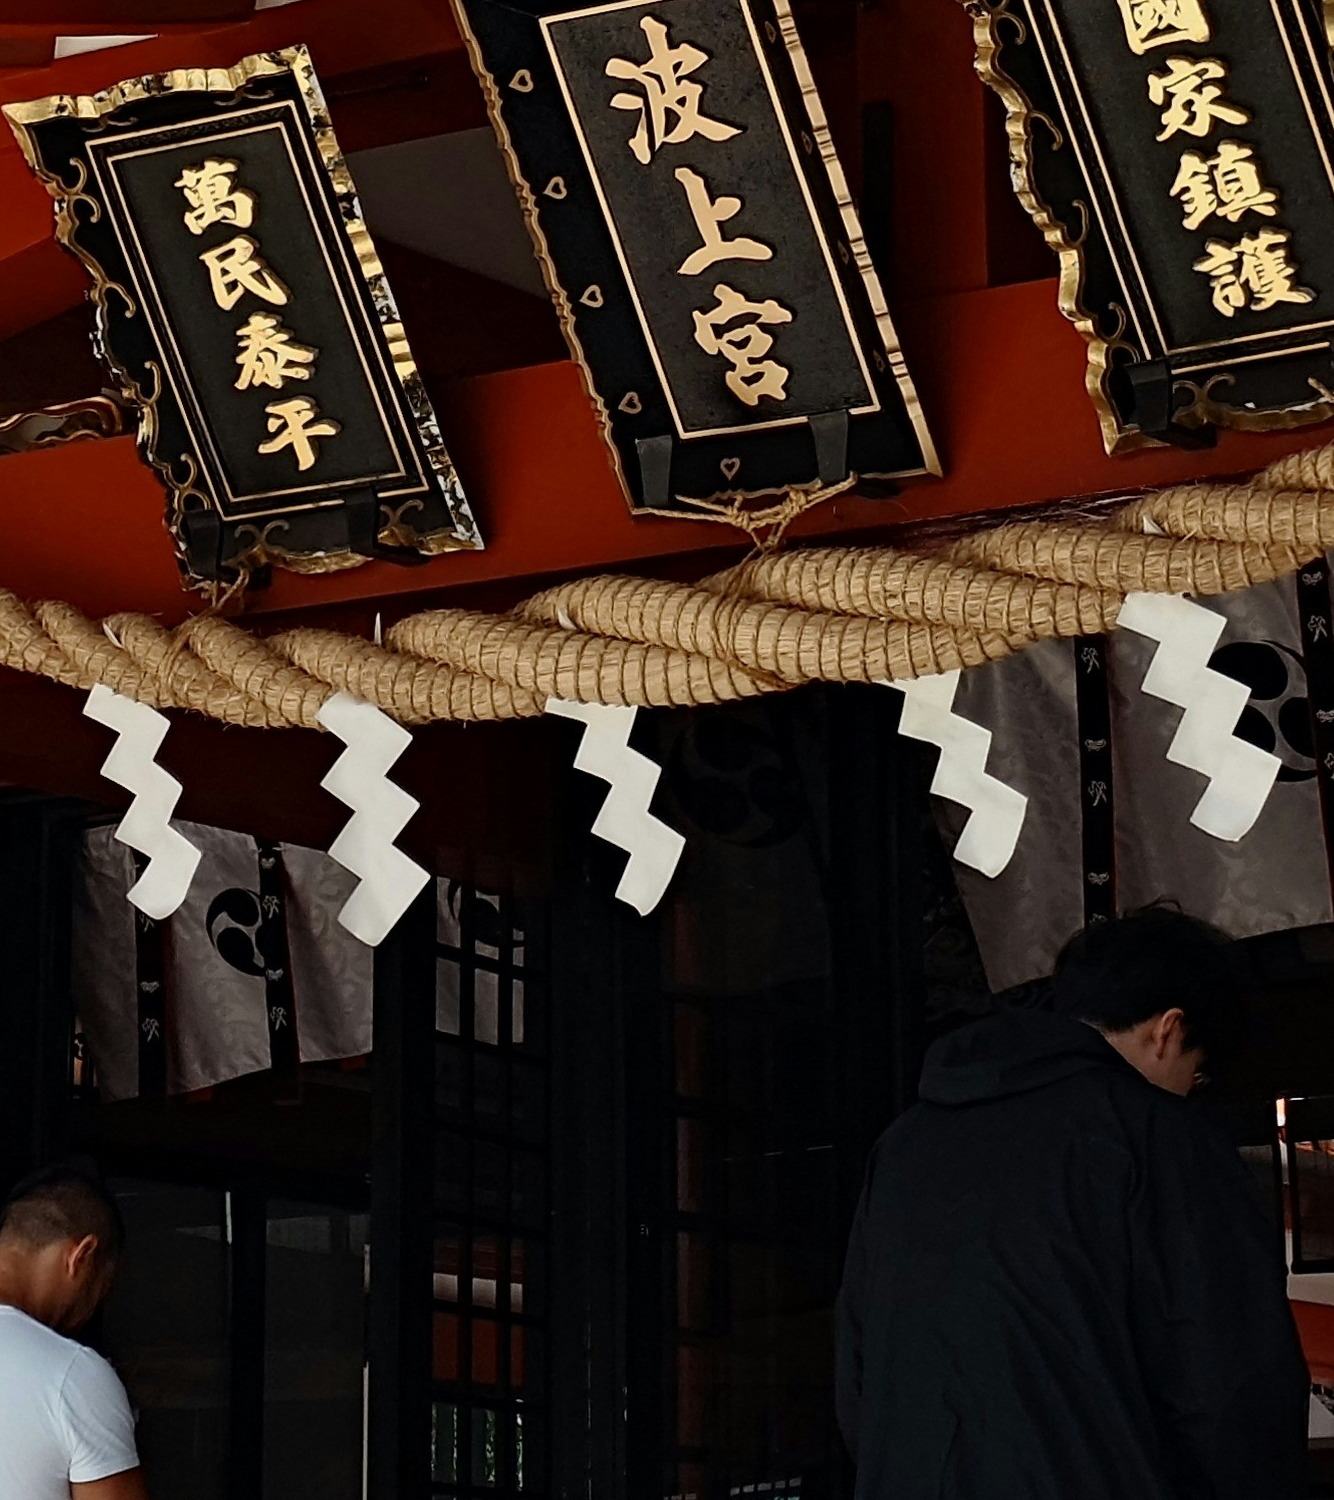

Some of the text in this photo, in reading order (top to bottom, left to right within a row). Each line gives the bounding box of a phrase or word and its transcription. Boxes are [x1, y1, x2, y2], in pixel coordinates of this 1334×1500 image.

[174, 157, 339, 472] 萬民泰平
[606, 16, 793, 406] 波上宮
